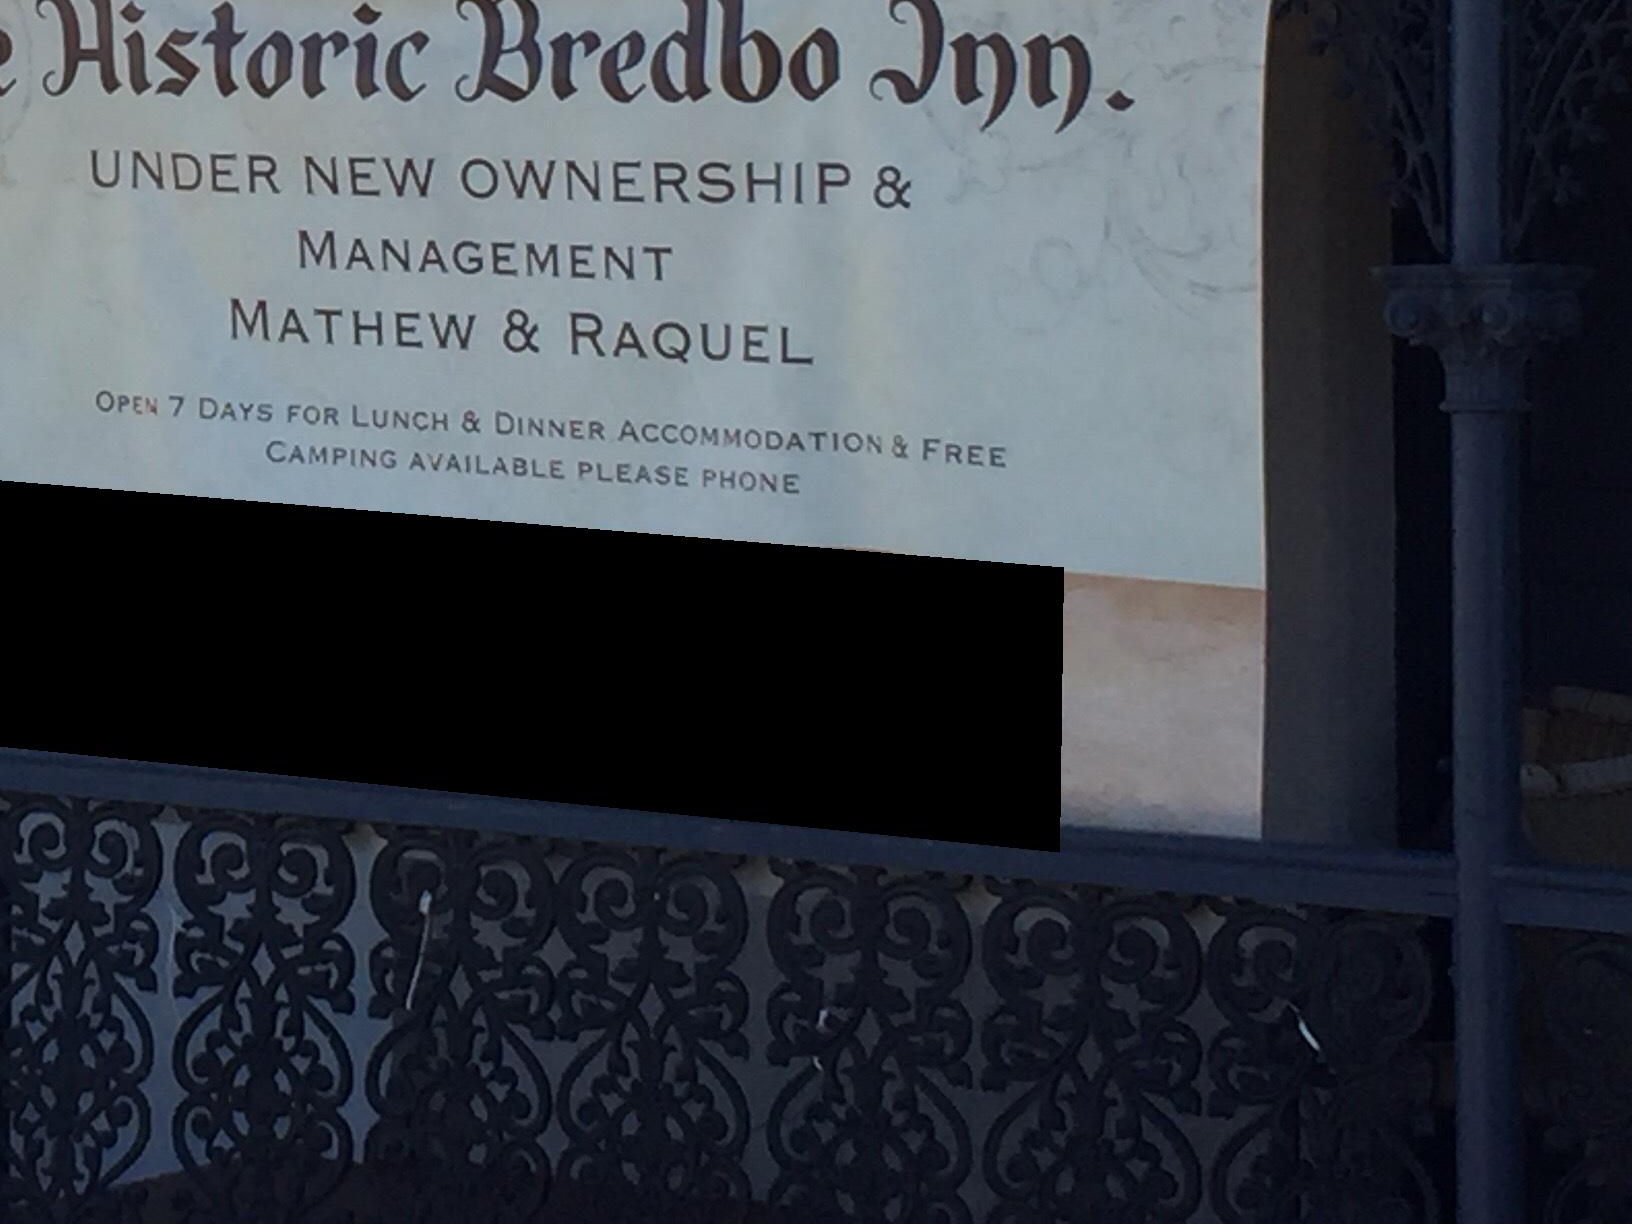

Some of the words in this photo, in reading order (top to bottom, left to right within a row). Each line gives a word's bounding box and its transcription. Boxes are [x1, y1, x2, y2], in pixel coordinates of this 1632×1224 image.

[90, 149, 282, 195] UNDER
[303, 155, 437, 199] NEW
[460, 157, 853, 205] OWNERSHIP
[872, 165, 913, 209] &
[297, 229, 674, 282] MANAGEMENT
[230, 297, 478, 351] MATHEW
[502, 308, 541, 354] &
[569, 311, 815, 366] RAQUEL
[168, 395, 185, 418] 7
[461, 409, 482, 434] &
[890, 434, 909, 459] &
